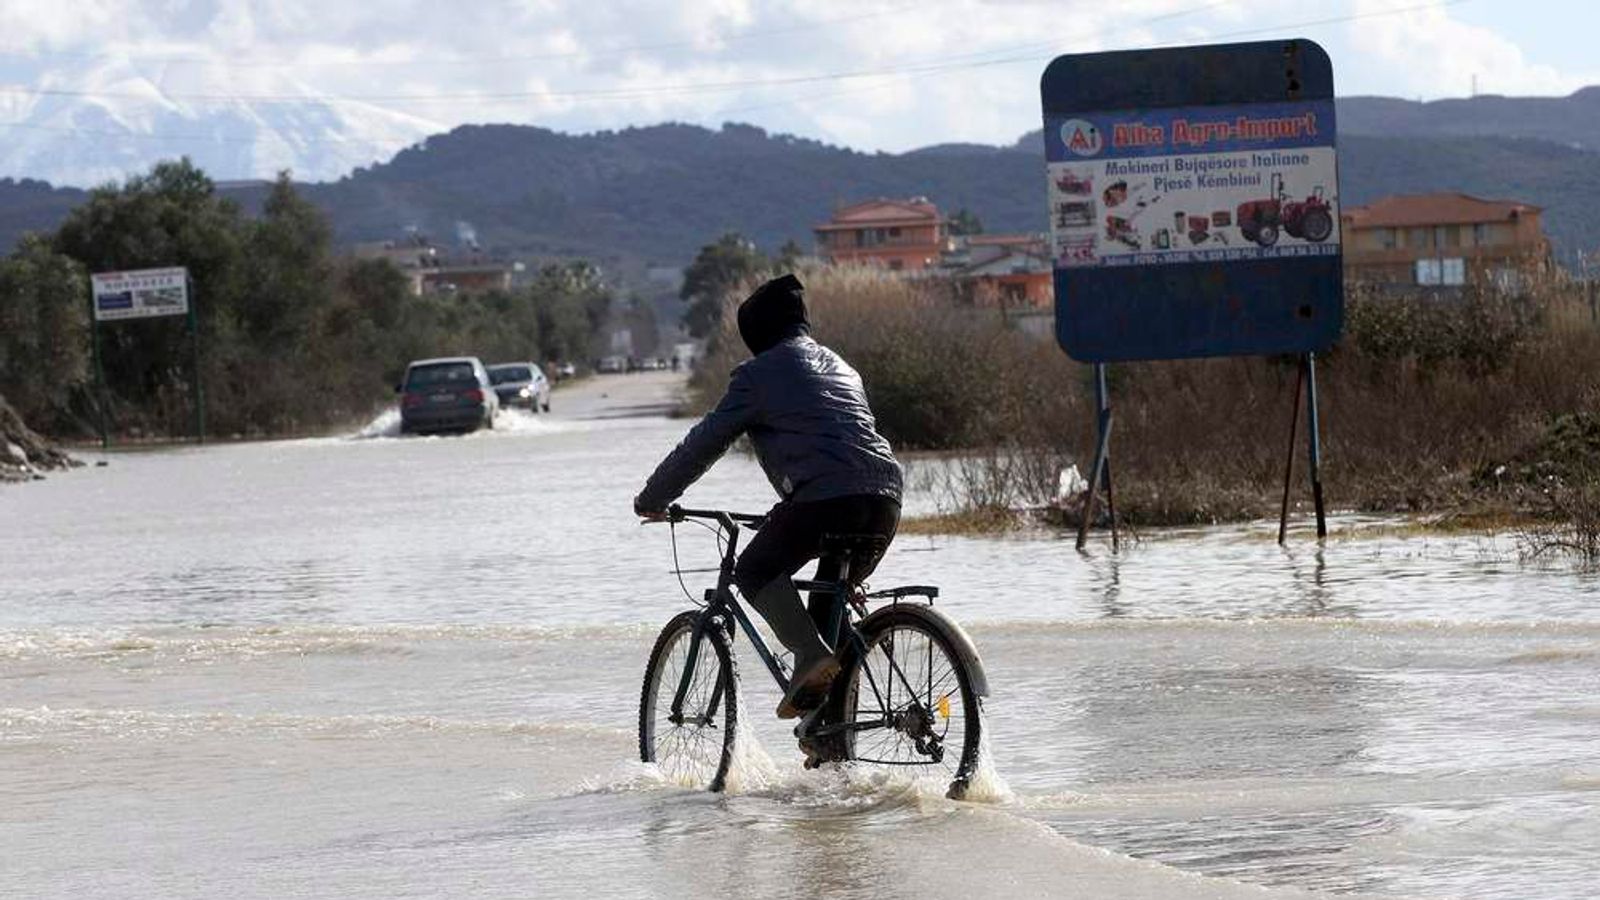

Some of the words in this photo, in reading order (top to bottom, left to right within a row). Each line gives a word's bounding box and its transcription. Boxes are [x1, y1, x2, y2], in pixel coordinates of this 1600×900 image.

[1113, 122, 1164, 148] Alba
[1172, 112, 1318, 146] Agro-Import
[1105, 159, 1170, 176] Makineri
[1174, 156, 1248, 173] Bujqësore
[1252, 153, 1310, 167] Italiane
[1153, 176, 1193, 193] Pjesë
[1197, 172, 1262, 188] Këmbimi
